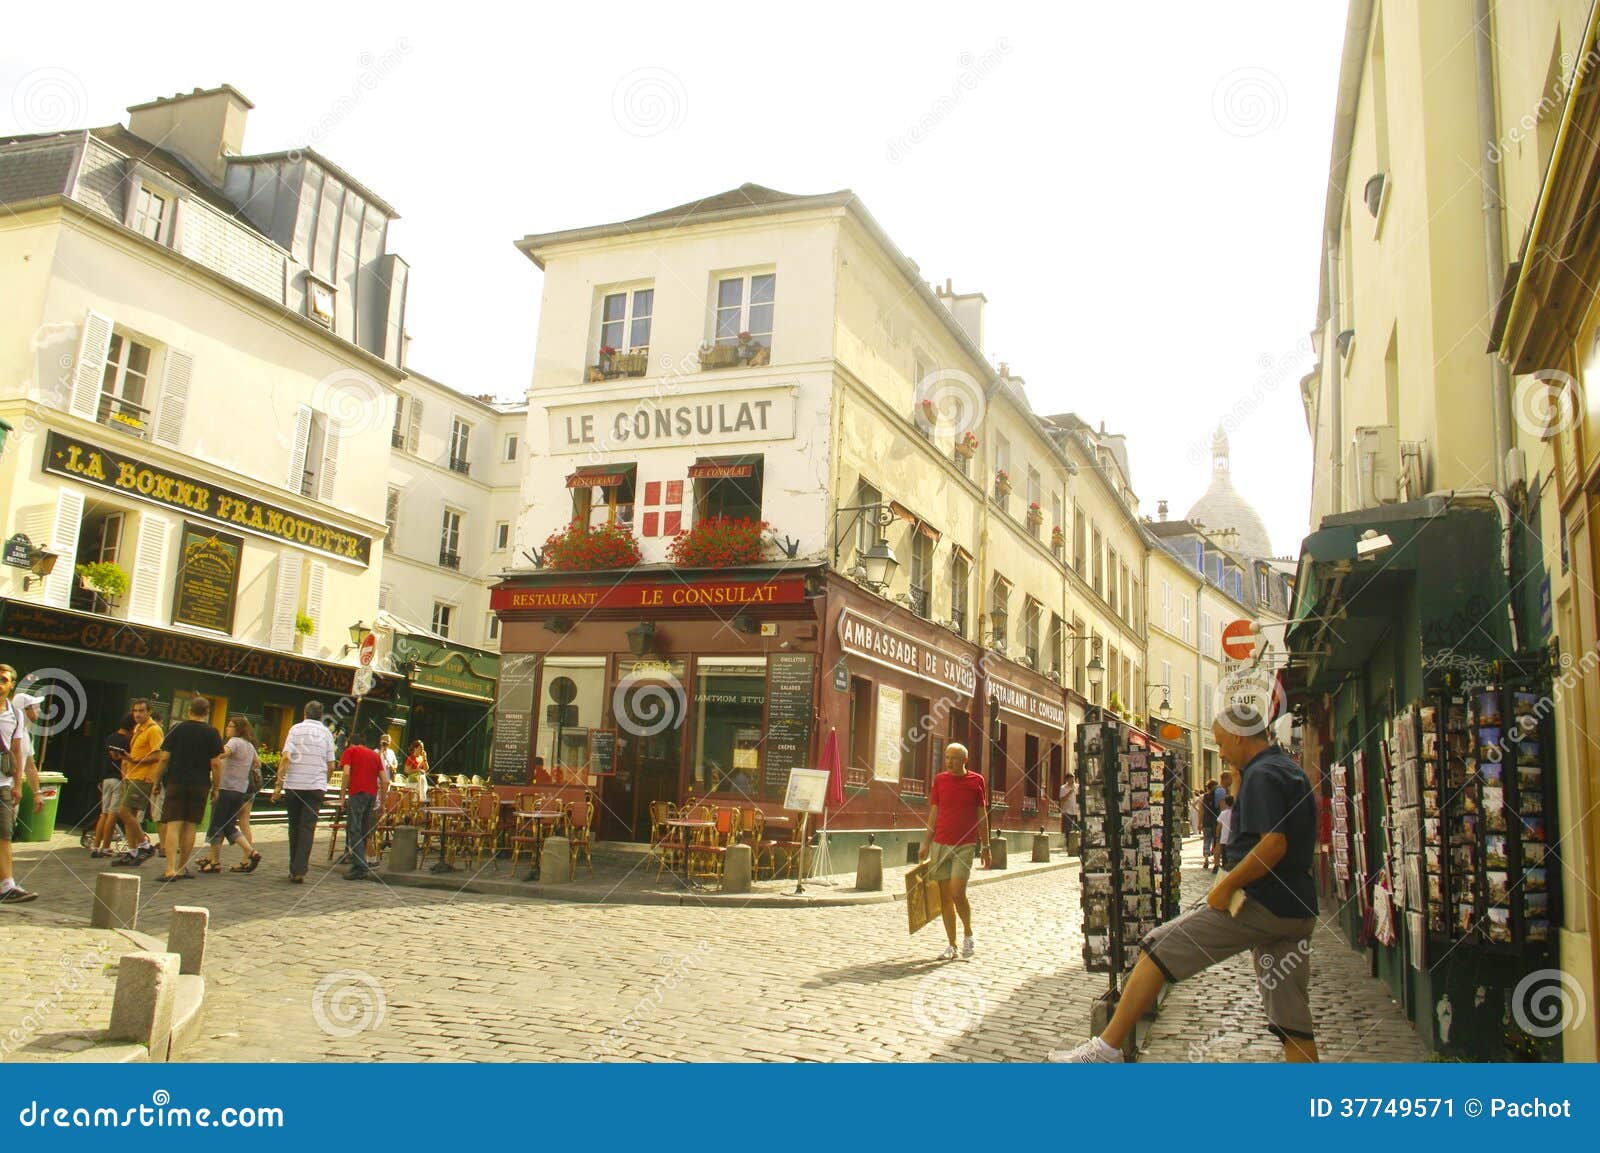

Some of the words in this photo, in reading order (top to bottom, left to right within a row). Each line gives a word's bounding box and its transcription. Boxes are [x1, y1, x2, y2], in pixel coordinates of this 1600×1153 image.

[566, 414, 595, 444] LE
[614, 400, 772, 441] CONSULAT
[65, 444, 106, 481] LA
[115, 461, 209, 512] BONNE
[693, 468, 703, 477] LE
[512, 592, 599, 606] RESTAURANT
[640, 590, 664, 605] LE
[672, 586, 778, 605] CONSULAT
[159, 636, 305, 683] RESTAURANT
[844, 619, 918, 667] AMBASSADE
[925, 651, 937, 674] DE
[944, 659, 973, 689] SAVOIE
[988, 681, 1028, 711] RESTAURANT
[1030, 697, 1037, 714] LE
[1230, 695, 1256, 704] SAUF
